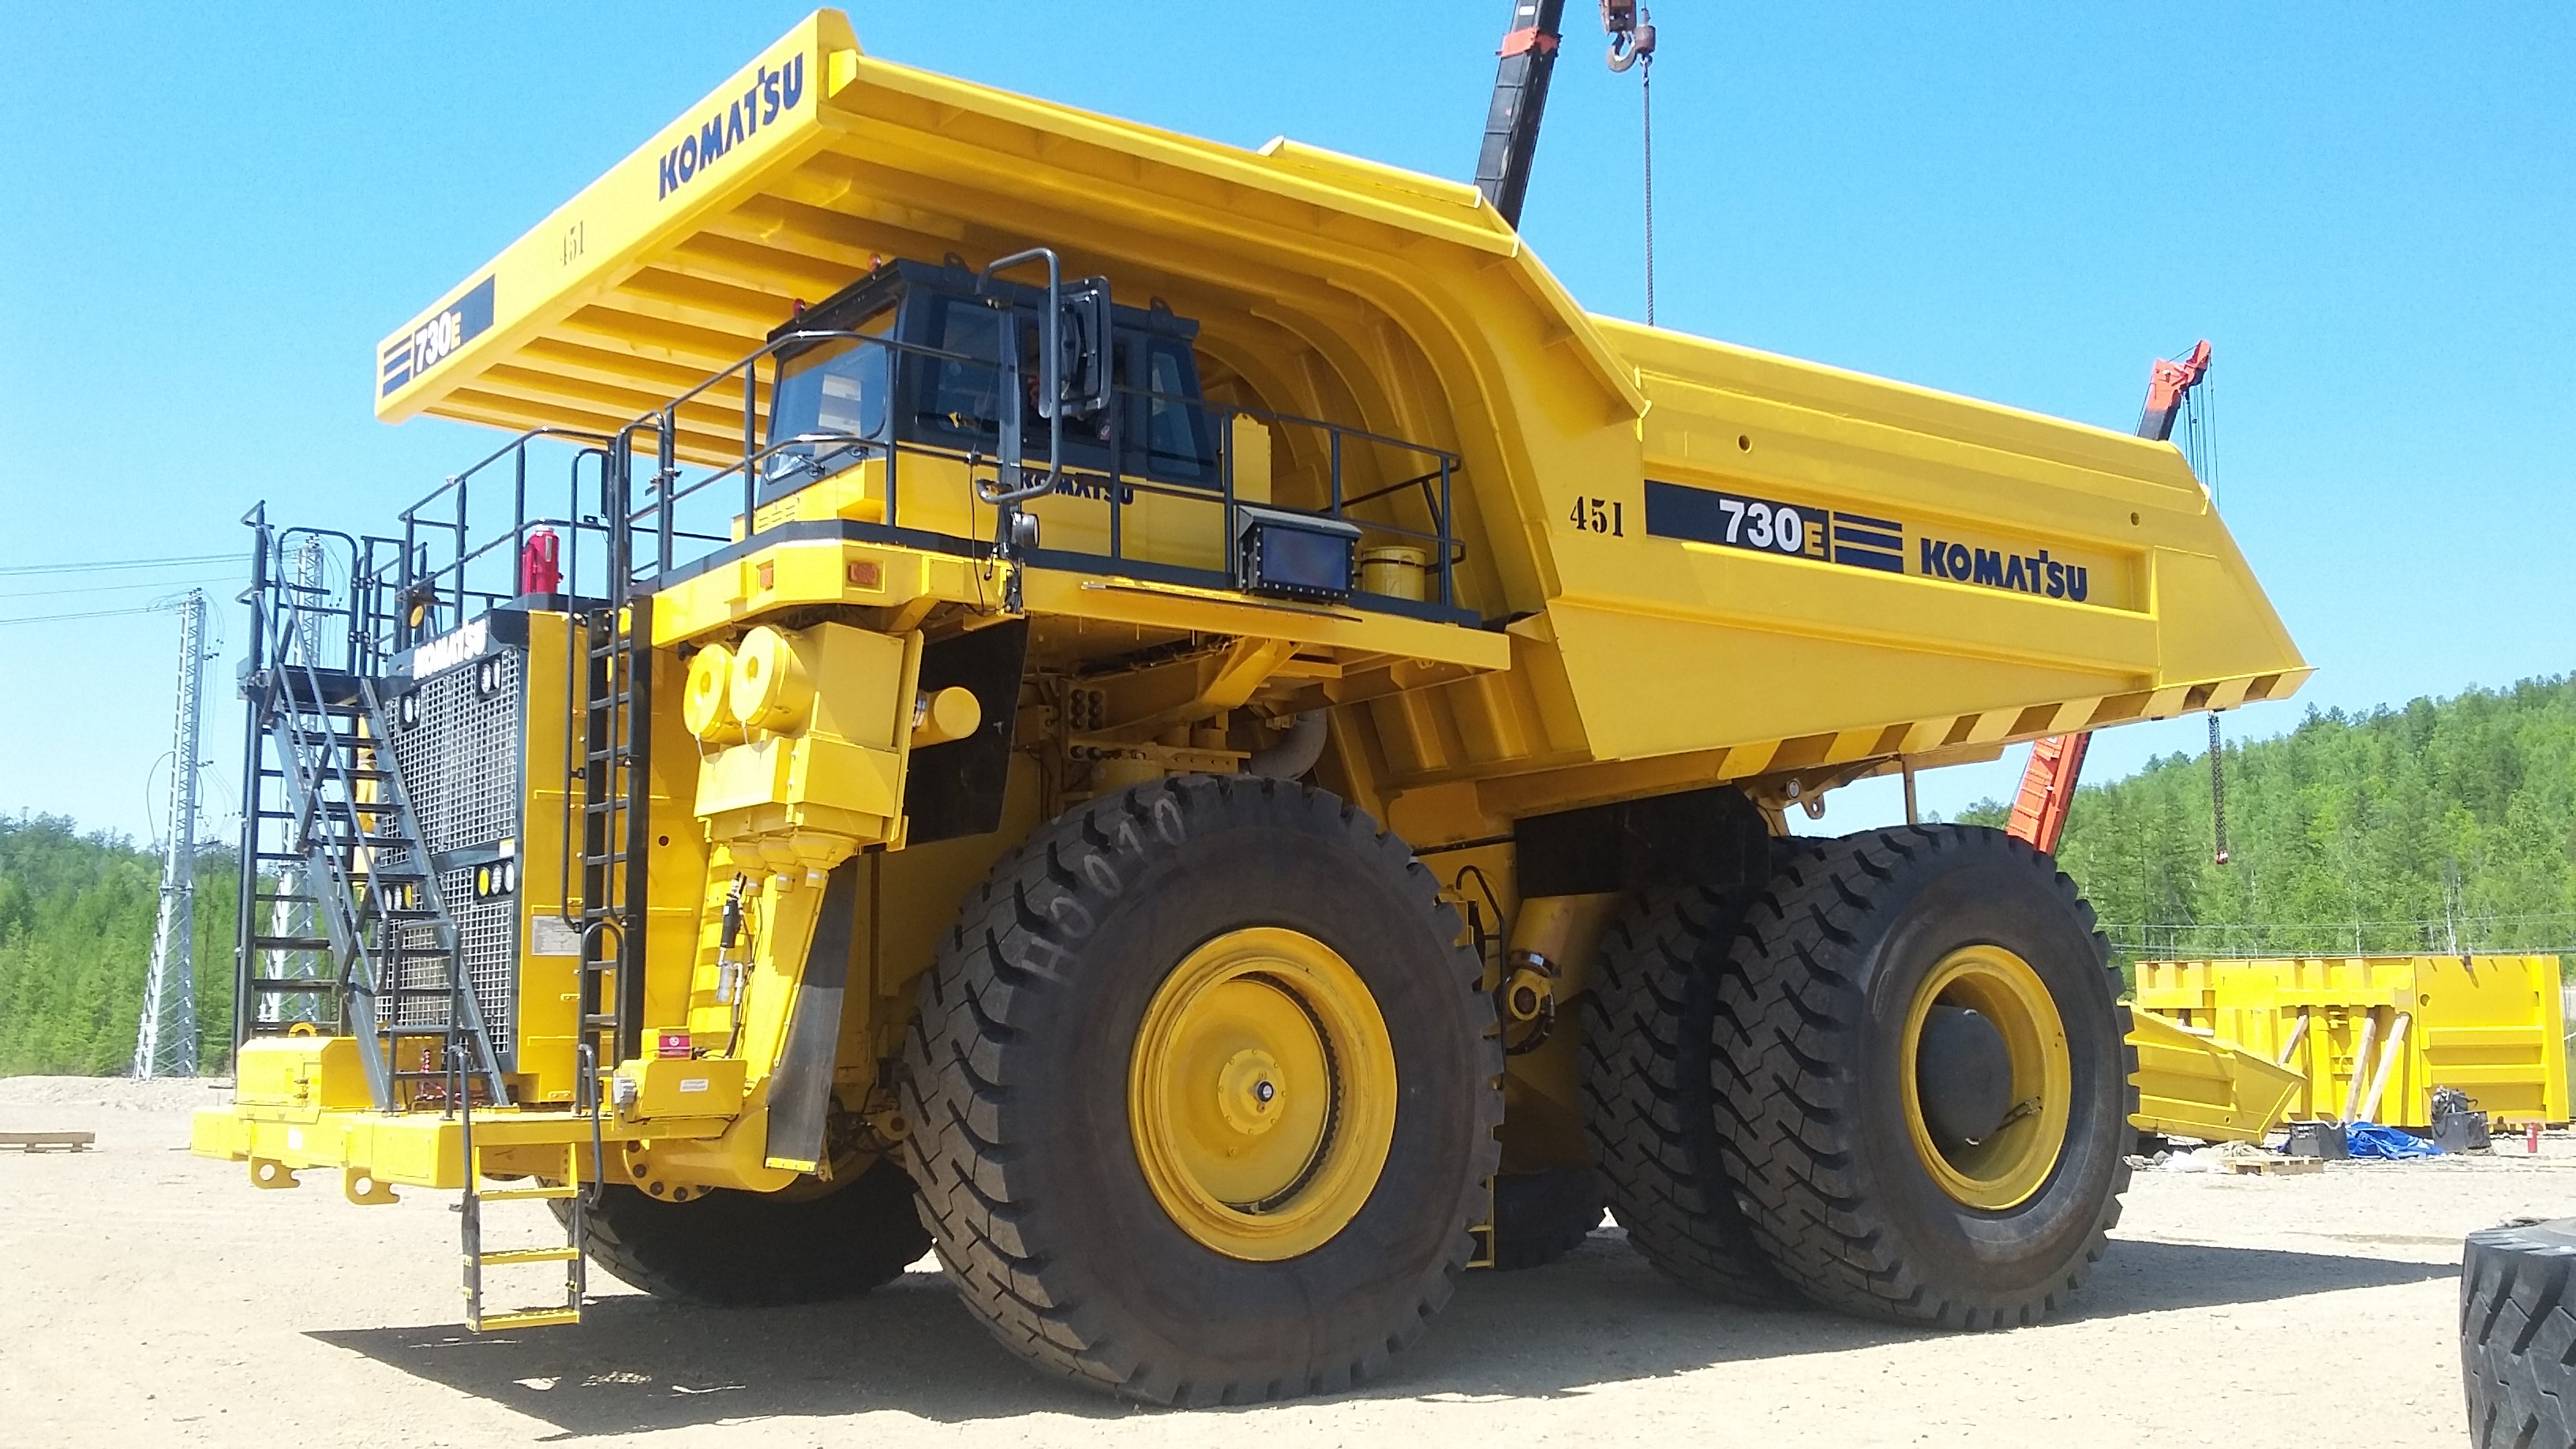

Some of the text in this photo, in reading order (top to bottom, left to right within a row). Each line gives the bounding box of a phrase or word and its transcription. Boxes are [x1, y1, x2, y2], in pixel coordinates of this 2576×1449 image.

[659, 52, 803, 201] KOMATSU
[561, 220, 585, 268] 451
[414, 311, 461, 373] 730E
[1569, 496, 1623, 537] 451
[1719, 499, 1823, 556] 730E
[1921, 537, 2088, 602] KOMATSU
[413, 618, 486, 680] KOMATSU
